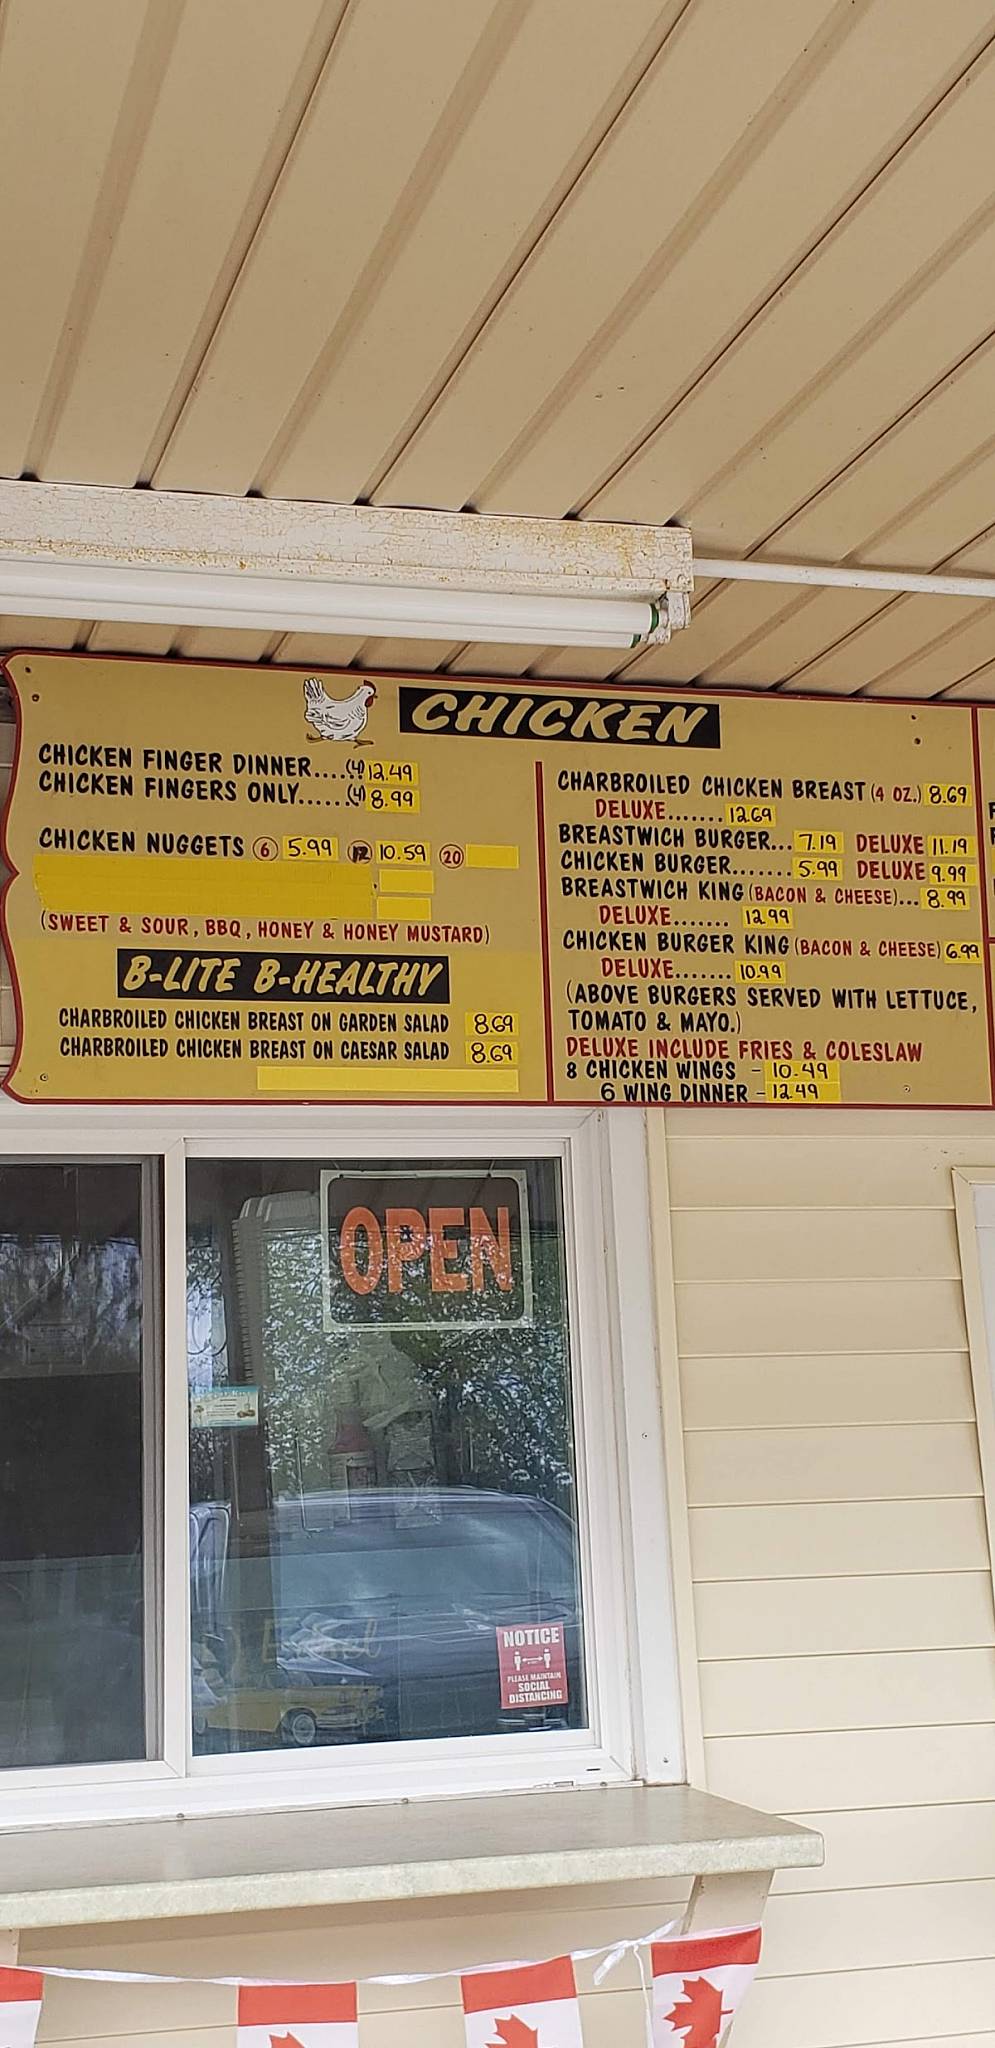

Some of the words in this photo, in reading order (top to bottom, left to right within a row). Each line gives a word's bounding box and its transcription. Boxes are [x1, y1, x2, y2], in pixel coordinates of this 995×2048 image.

[411, 692, 708, 743] CHICKEN
[38, 743, 132, 768] CHICKEN
[143, 749, 222, 773] FINGER
[368, 763, 413, 782] 12.49
[38, 770, 133, 796] CHICKEN
[144, 777, 237, 801] FINGERS
[371, 789, 413, 809] 8.99
[557, 770, 690, 795] CHARBROILED
[702, 776, 783, 799] CHICKEN
[792, 779, 866, 801] BREAST
[871, 783, 884, 803] (4
[893, 785, 922, 804] OZ.)
[928, 785, 967, 804] 8.69
[730, 807, 772, 823] 12.69
[39, 827, 135, 852] CHICKEN
[147, 832, 245, 857] NUGGETS
[260, 842, 270, 857] 6
[288, 838, 332, 857] 5.99
[380, 844, 426, 861] 10.59
[443, 849, 461, 864] 20
[559, 823, 684, 848] BREASTWICH
[799, 833, 836, 851] 7.19
[856, 834, 924, 855] DELUXE
[932, 839, 967, 856] 11.19
[561, 850, 644, 872] CHICKEN
[798, 860, 838, 877] 5.99
[857, 860, 926, 881] DELUXE
[931, 865, 966, 883] 9.99
[561, 876, 688, 900] BREASTWICH
[700, 881, 744, 901] KING
[749, 884, 806, 904] (BACON
[815, 888, 826, 903] &
[926, 889, 966, 909] 8.99
[41, 910, 110, 932] (SWEET
[119, 917, 132, 933] &
[258, 921, 314, 939] HONEY
[322, 923, 335, 940] &
[344, 923, 399, 942] HONEY
[407, 925, 490, 944] MUSTARD)
[746, 909, 790, 925] 12.99
[563, 930, 647, 951] CHICKEN
[657, 932, 735, 954] BURGER
[744, 934, 790, 955] KING
[794, 937, 852, 957] (BACON
[859, 940, 871, 956] &
[878, 940, 941, 960] CHEESE)
[946, 943, 980, 960] 6.99
[123, 955, 242, 992] B-LITE
[253, 958, 443, 996] B-HEALTHY
[740, 964, 781, 980] 10.99
[566, 979, 639, 1005] (ABOVE
[648, 984, 737, 1007] BURGERS
[747, 986, 821, 1009] SERVED
[832, 988, 877, 1010] WITH
[887, 989, 977, 1014] LETTUCE,
[59, 1007, 167, 1029] CHARBROILED
[174, 1010, 240, 1030] CHICKEN
[247, 1011, 304, 1031] BREAST
[311, 1012, 331, 1031] ON
[339, 1013, 397, 1032] GARDEN
[404, 1014, 449, 1033] SALAD
[474, 1013, 514, 1035] 8.69
[568, 1009, 647, 1031] TOMATO
[656, 1012, 671, 1031] &
[681, 1011, 742, 1035] MAYO.)
[60, 1037, 168, 1057] CHARBROILED
[176, 1039, 242, 1058] CHICKEN
[249, 1039, 306, 1059] BREAST
[313, 1040, 333, 1059] ON
[341, 1041, 397, 1060] CAESAR
[404, 1041, 449, 1060] SALAD
[471, 1042, 513, 1063] 8.69
[566, 1036, 639, 1058] DELUXE
[650, 1038, 730, 1060] INCLUDE
[739, 1040, 793, 1061] FRIES
[803, 1041, 817, 1060] &
[826, 1041, 923, 1063] COLESLAW
[566, 1061, 578, 1080] 8
[586, 1060, 669, 1080] CHICKEN
[677, 1061, 736, 1080] WINGS
[773, 1062, 829, 1080] 10.49
[601, 1082, 616, 1102] 6
[624, 1084, 672, 1104] WING
[680, 1084, 749, 1103] DINNER
[773, 1083, 819, 1100] 12.49
[338, 1206, 512, 1296] OPEN
[503, 1627, 560, 1648] NOTICE
[507, 1674, 529, 1683] PLEASE
[530, 1671, 562, 1681] MAINTAIN
[518, 1681, 551, 1692] SOCIAL
[509, 1690, 563, 1704] DISTANCING
